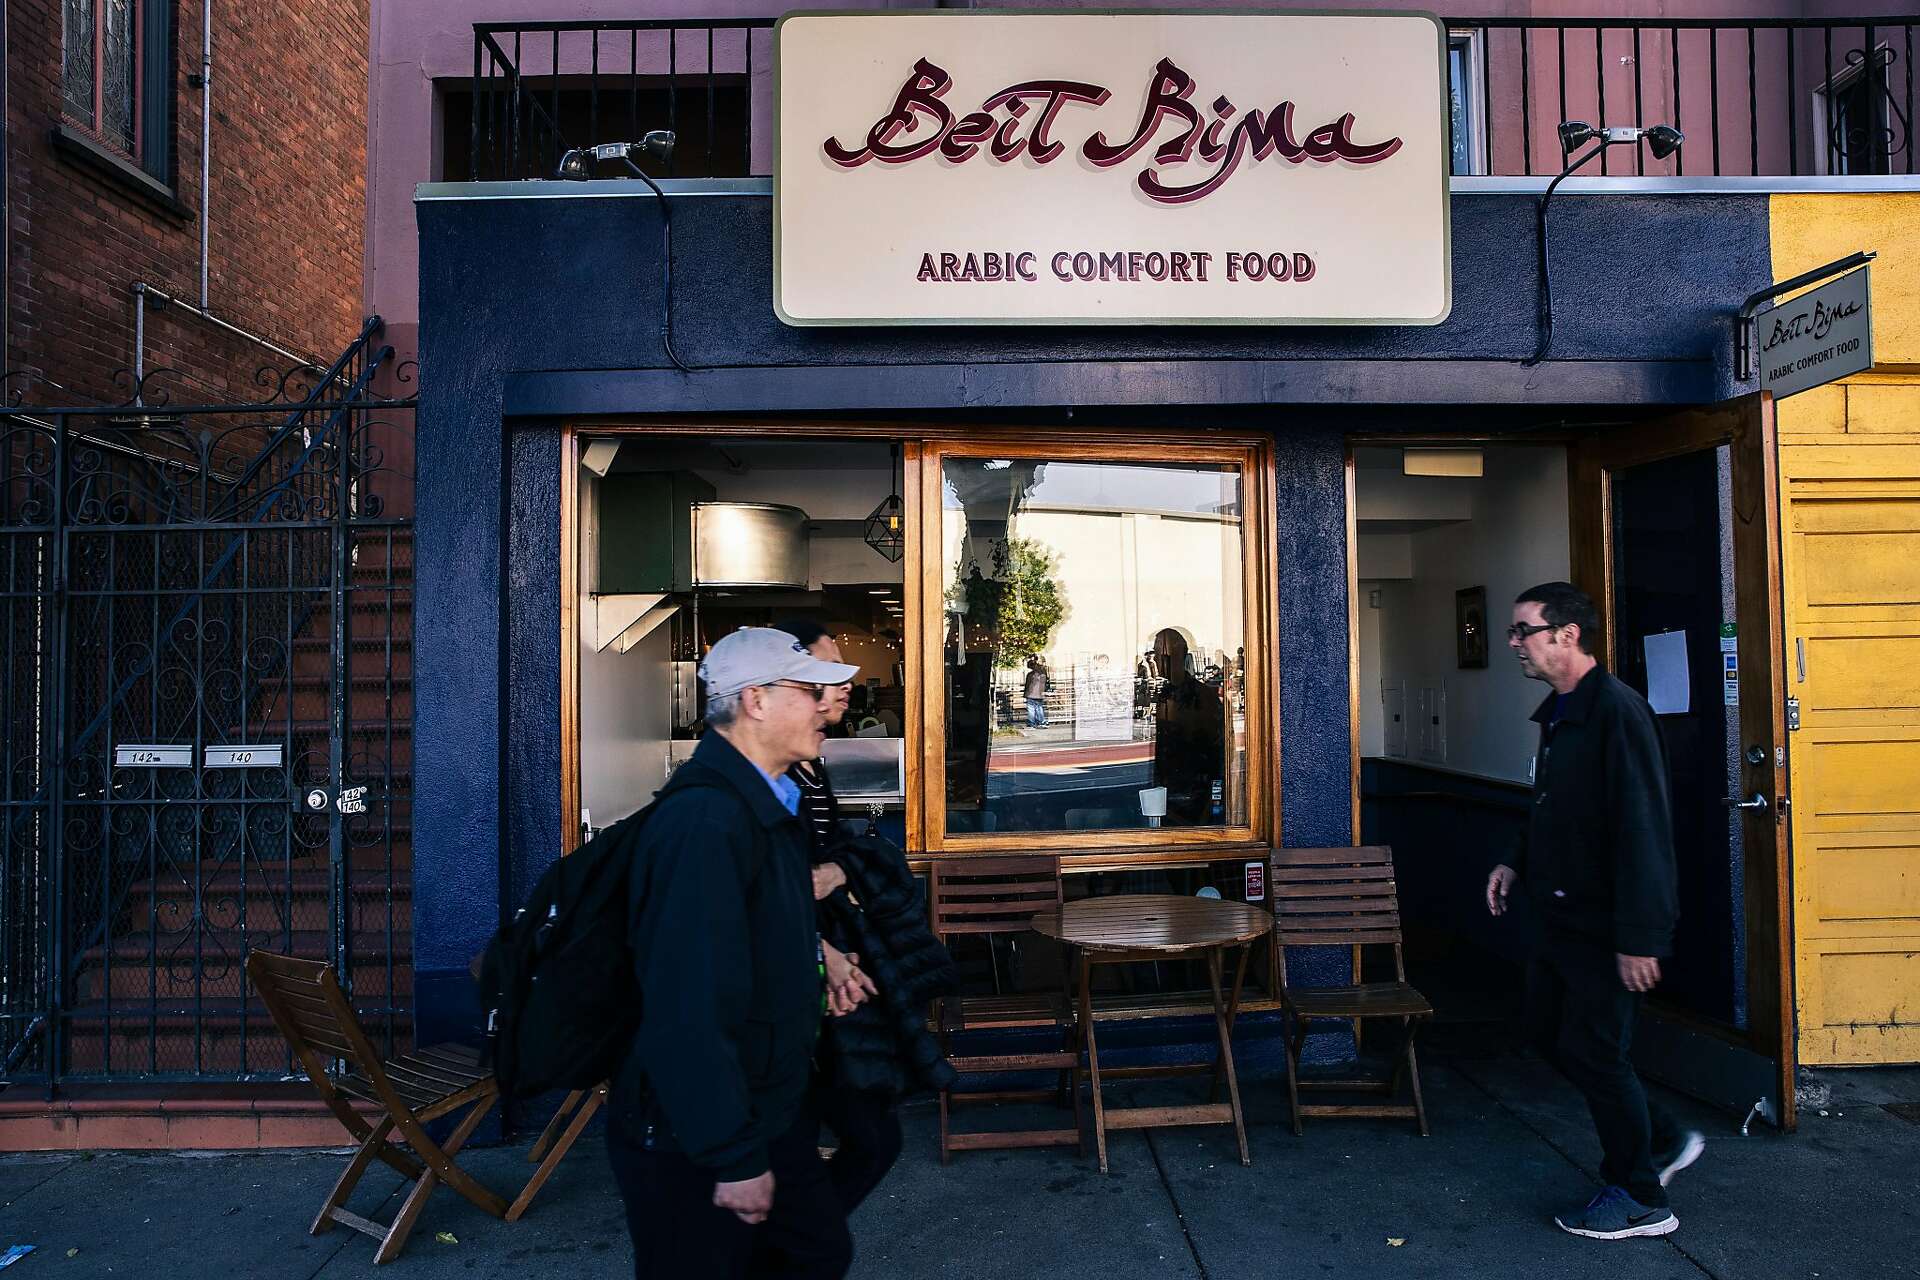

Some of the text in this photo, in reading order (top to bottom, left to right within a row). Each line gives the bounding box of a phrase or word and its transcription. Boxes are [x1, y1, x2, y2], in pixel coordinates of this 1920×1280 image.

[917, 252, 1316, 282] ARABIC COMFORT FOOD
[1768, 338, 1860, 382] ARABIC COMFORT FOOD
[231, 752, 251, 763] 140
[344, 801, 360, 812] 140
